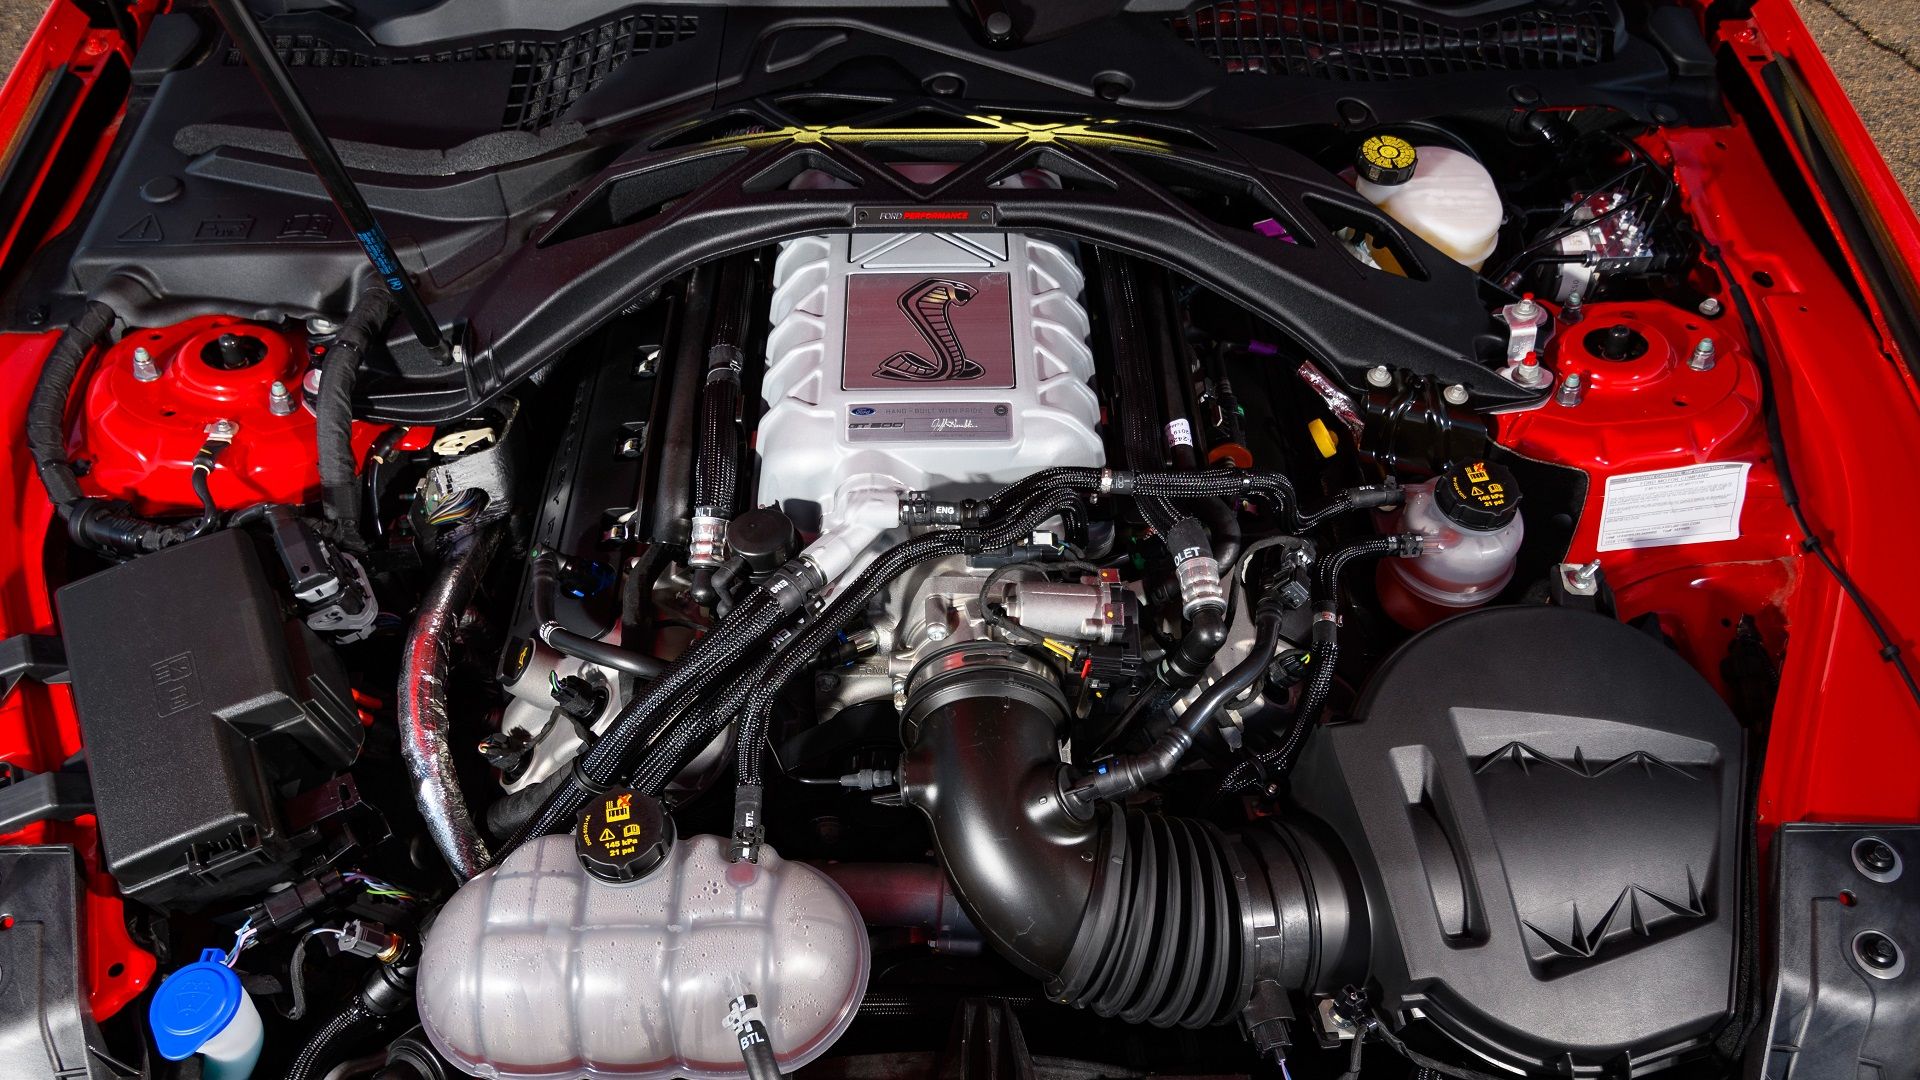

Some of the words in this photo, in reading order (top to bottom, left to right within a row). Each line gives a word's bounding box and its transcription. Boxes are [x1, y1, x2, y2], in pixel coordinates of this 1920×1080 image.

[880, 212, 902, 220] FORD
[904, 211, 969, 220] PERFORMANCE
[935, 505, 955, 515] ENG
[770, 579, 789, 594] ENG
[745, 810, 755, 828] BTL
[604, 840, 621, 850] 145
[621, 838, 639, 847] kPa
[609, 849, 620, 858] 21
[621, 846, 636, 856] psi
[740, 1031, 765, 1051] BTL
